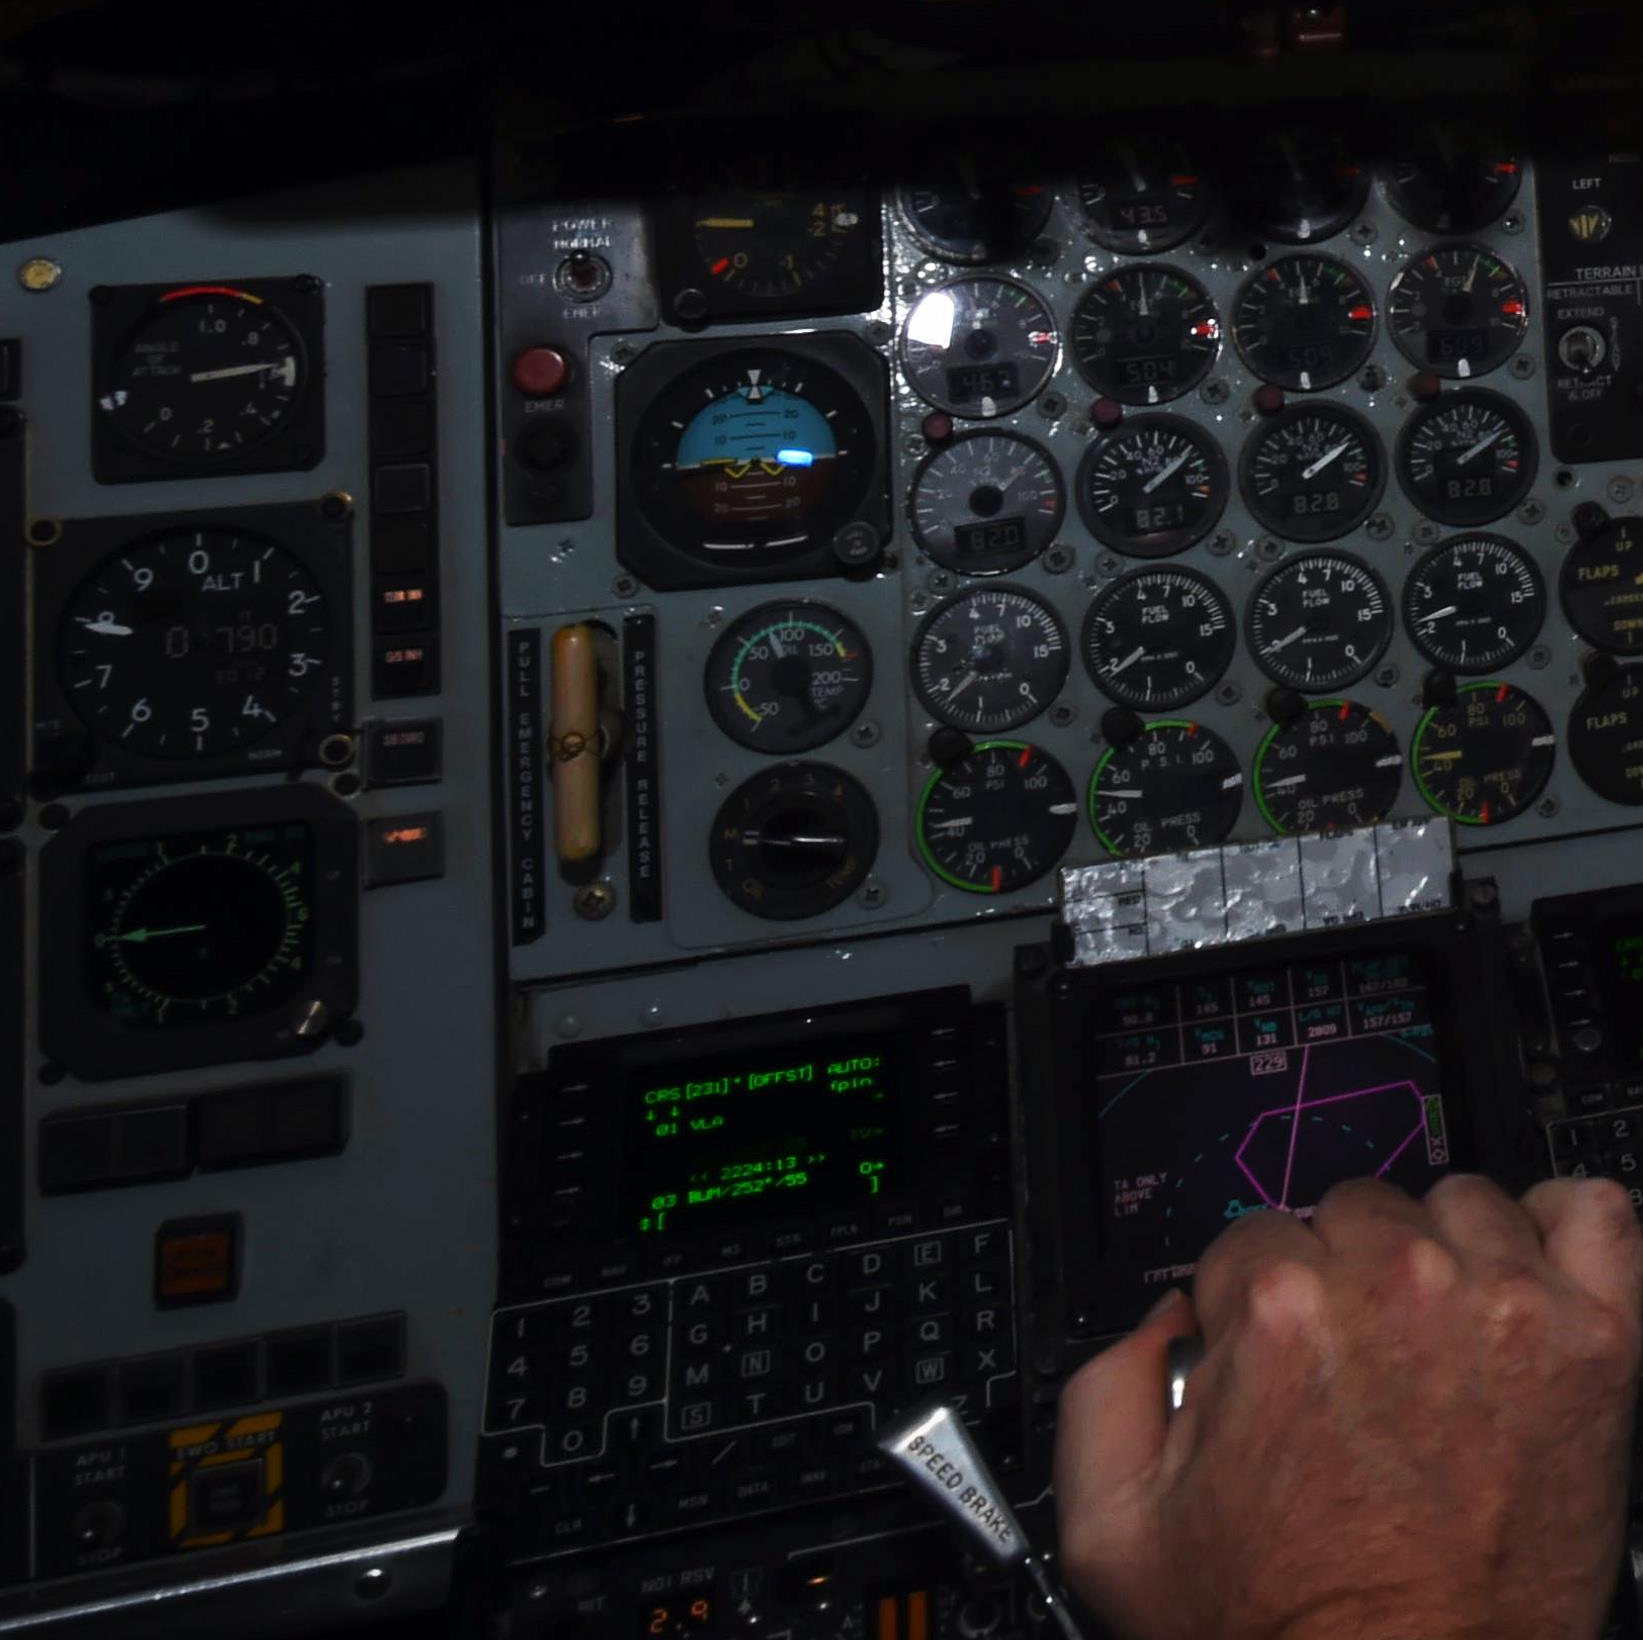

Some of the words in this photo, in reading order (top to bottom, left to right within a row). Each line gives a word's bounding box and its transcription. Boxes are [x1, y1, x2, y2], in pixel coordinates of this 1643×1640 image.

[1572, 177, 1602, 190] LEFT
[1576, 265, 1636, 281] TERRAIN
[1615, 540, 1633, 552] UP
[1457, 571, 1482, 582] FUEL
[1577, 563, 1620, 581] FLAPS
[201, 574, 244, 592] ALT
[1457, 579, 1484, 590] FLOW
[1302, 589, 1328, 600] FUEL
[1302, 597, 1331, 607] FLOW
[1141, 606, 1167, 616] FUEL
[779, 628, 804, 642] 100
[808, 643, 833, 657] 150
[518, 642, 530, 697] PULL
[1622, 686, 1640, 700] UP
[634, 650, 646, 763] PRESSURE
[1586, 712, 1628, 730] FLAPS
[1345, 730, 1369, 745] 100
[1191, 750, 1215, 764] 100
[518, 712, 533, 842] EMERGENCY
[1024, 776, 1048, 790] 100
[1322, 788, 1364, 804] PRESS
[1160, 811, 1202, 829] PRESS
[636, 778, 651, 879] RELEASE
[521, 857, 536, 929] CABIN
[1253, 1053, 1285, 1072] 229
[644, 1085, 681, 1106] CRS
[690, 1113, 726, 1132] VLA
[908, 1436, 963, 1489] SPEED
[960, 1486, 1011, 1544] BRAKE
